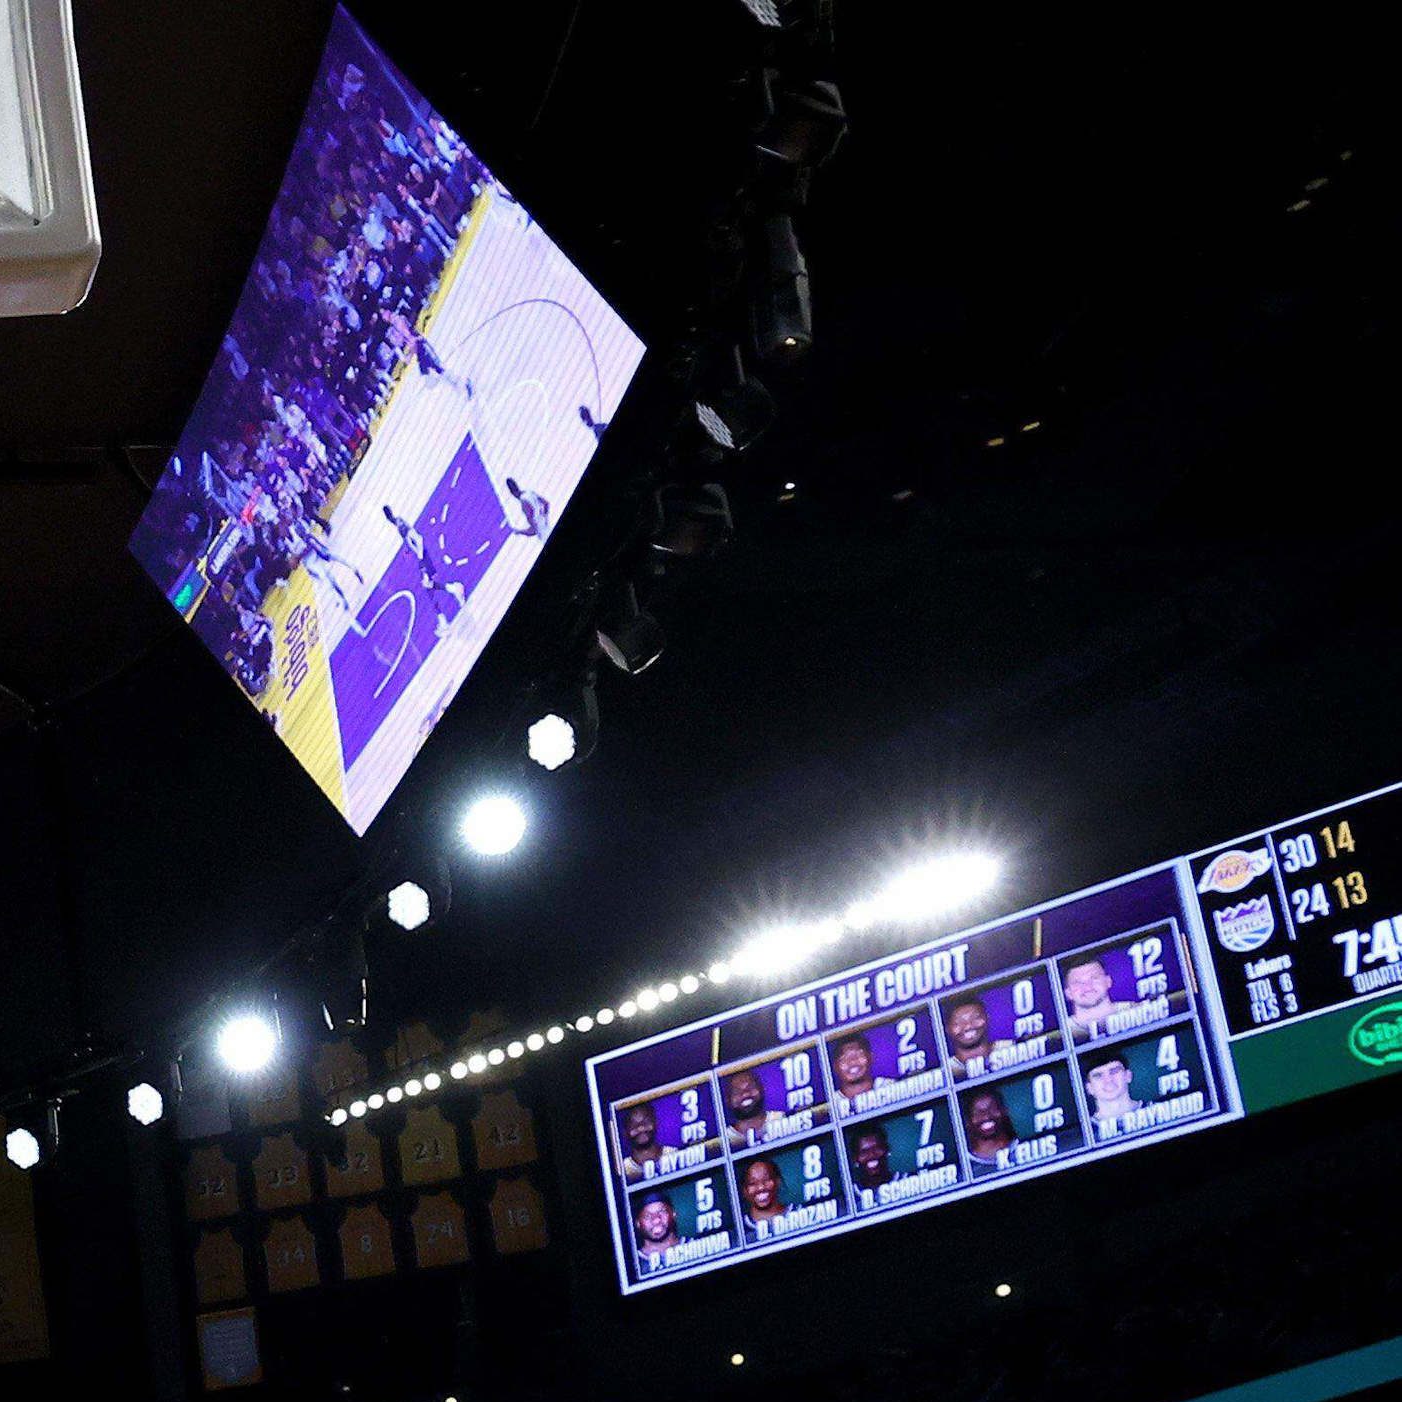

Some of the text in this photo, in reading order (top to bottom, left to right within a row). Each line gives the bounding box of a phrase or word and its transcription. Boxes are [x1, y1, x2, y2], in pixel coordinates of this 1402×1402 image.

[282, 604, 310, 701] bibigo
[1279, 834, 1317, 873] 30
[1320, 820, 1355, 859] 14
[1292, 871, 1368, 923] 24 13
[1127, 938, 1163, 977] 12
[776, 944, 969, 1041] ON THE COURT
[1012, 980, 1034, 1015] 0
[1136, 973, 1168, 998] PTS
[897, 1018, 917, 1054] 2
[1015, 1013, 1043, 1038] PTS
[898, 1051, 926, 1075] PTS
[989, 1035, 1046, 1070] SMART
[1156, 1035, 1180, 1070] 4
[780, 1053, 811, 1088] 10
[1158, 1070, 1190, 1095] PTS
[787, 1087, 814, 1110] PTS
[856, 1067, 944, 1111] HACHIMURA
[1032, 1074, 1053, 1110] 0
[680, 1090, 699, 1123] 3
[1034, 1107, 1064, 1132] PTS
[1124, 1091, 1204, 1133] RAYNAUD
[681, 1121, 707, 1145] PTS
[763, 1111, 813, 1139] JAMES
[915, 1109, 934, 1145] 7
[659, 1145, 706, 1175] AYTON
[803, 1145, 822, 1179] 8
[916, 1144, 944, 1167] PTS
[1015, 1135, 1057, 1162] ELLIS
[695, 1178, 714, 1212] 5
[804, 1178, 830, 1200] PTS
[696, 1210, 722, 1232] PTS
